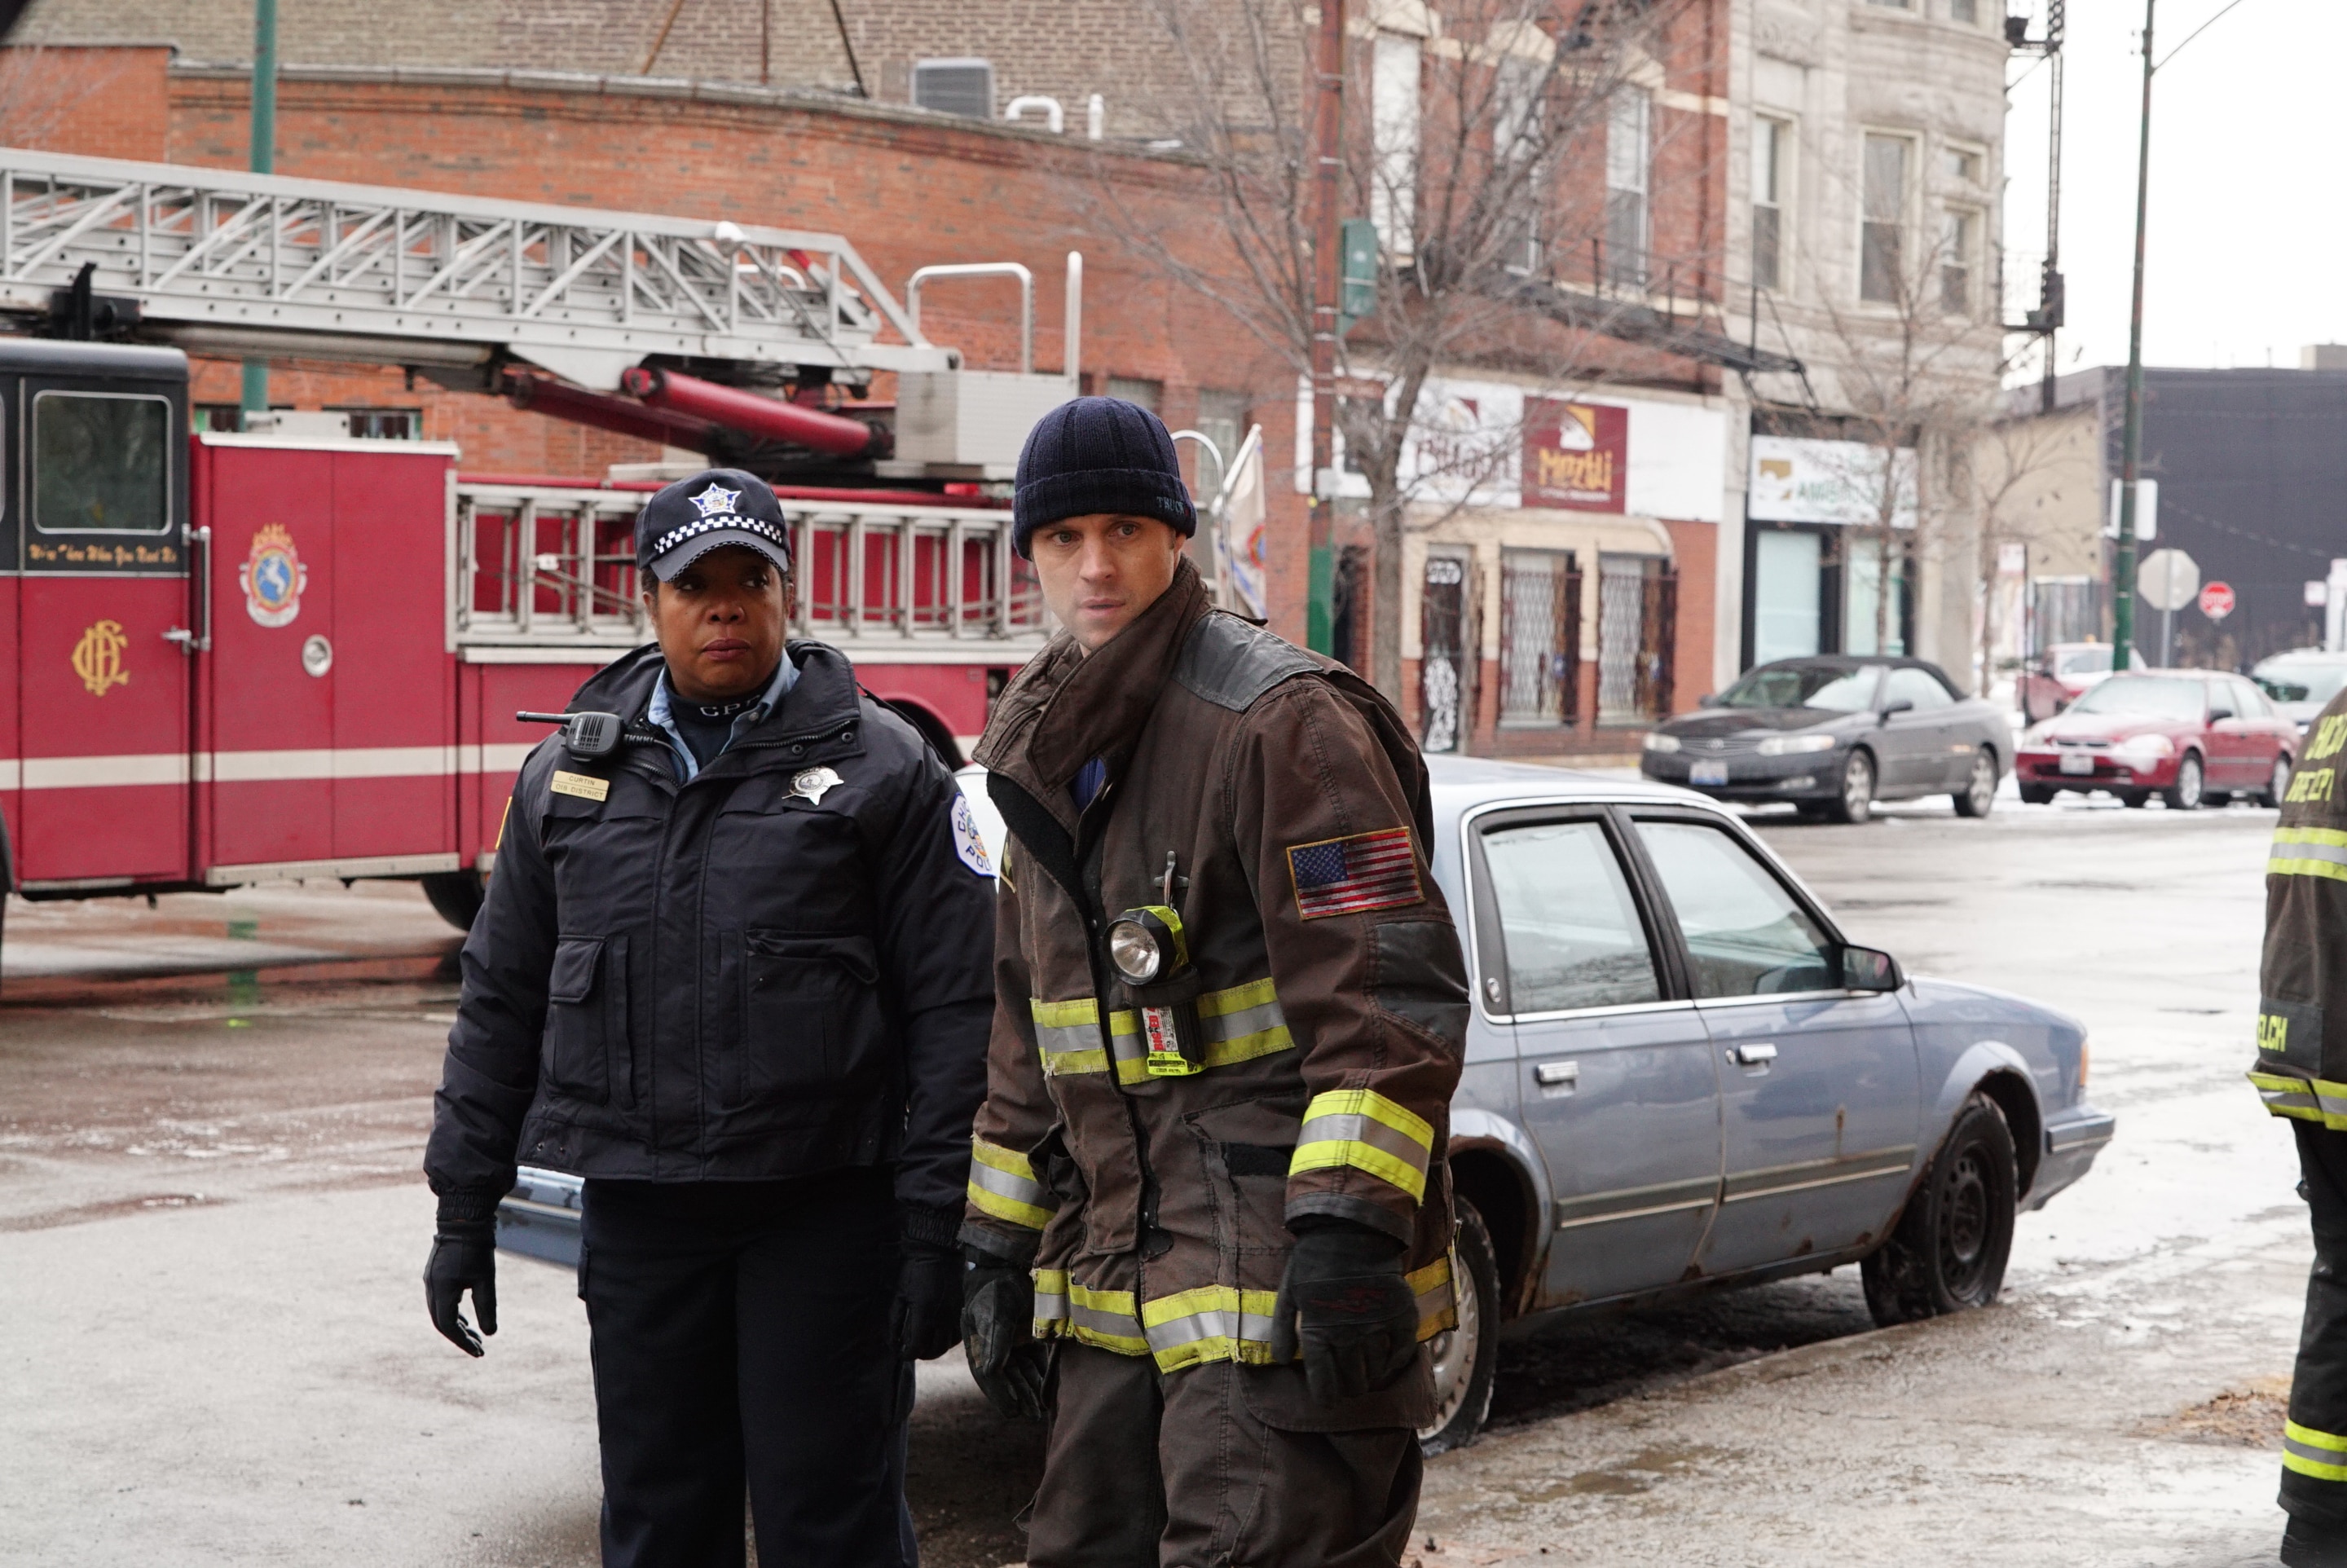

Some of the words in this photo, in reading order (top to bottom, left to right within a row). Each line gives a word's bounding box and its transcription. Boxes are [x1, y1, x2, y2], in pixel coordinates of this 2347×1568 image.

[569, 775, 596, 786] CURTIN
[570, 786, 604, 798] DISTRICT
[1148, 1015, 1160, 1028] ED
[1151, 1033, 1165, 1050] BIG
